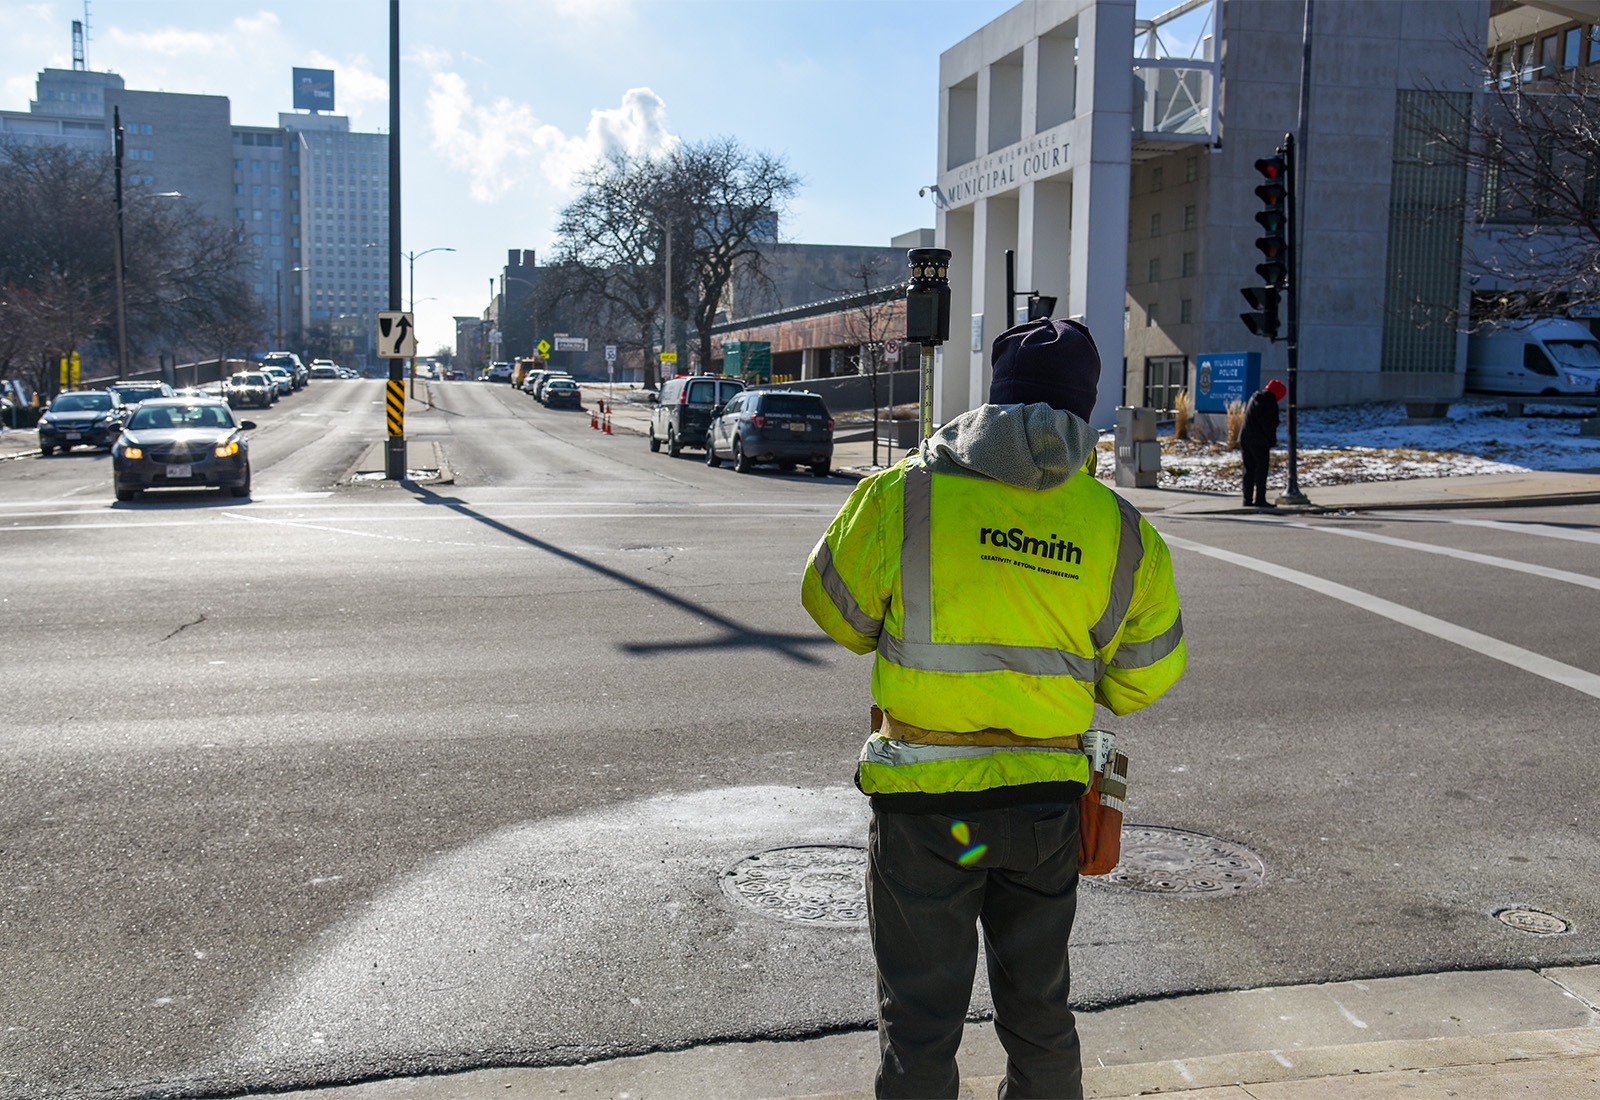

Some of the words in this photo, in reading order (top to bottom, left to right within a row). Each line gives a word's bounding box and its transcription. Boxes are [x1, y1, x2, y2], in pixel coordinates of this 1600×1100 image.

[948, 164, 1015, 203] MUNICIPAL
[1023, 143, 1070, 176] COURT
[959, 165, 979, 180] CITY
[984, 159, 993, 171] OF
[998, 133, 1056, 164] MILWAUKEE
[1219, 369, 1238, 377] POLICE
[980, 528, 1083, 565] raSmith
[981, 554, 1012, 564] CREATIVITY
[1013, 560, 1036, 571] BEYOND
[1037, 567, 1080, 580] ENGINEERING
